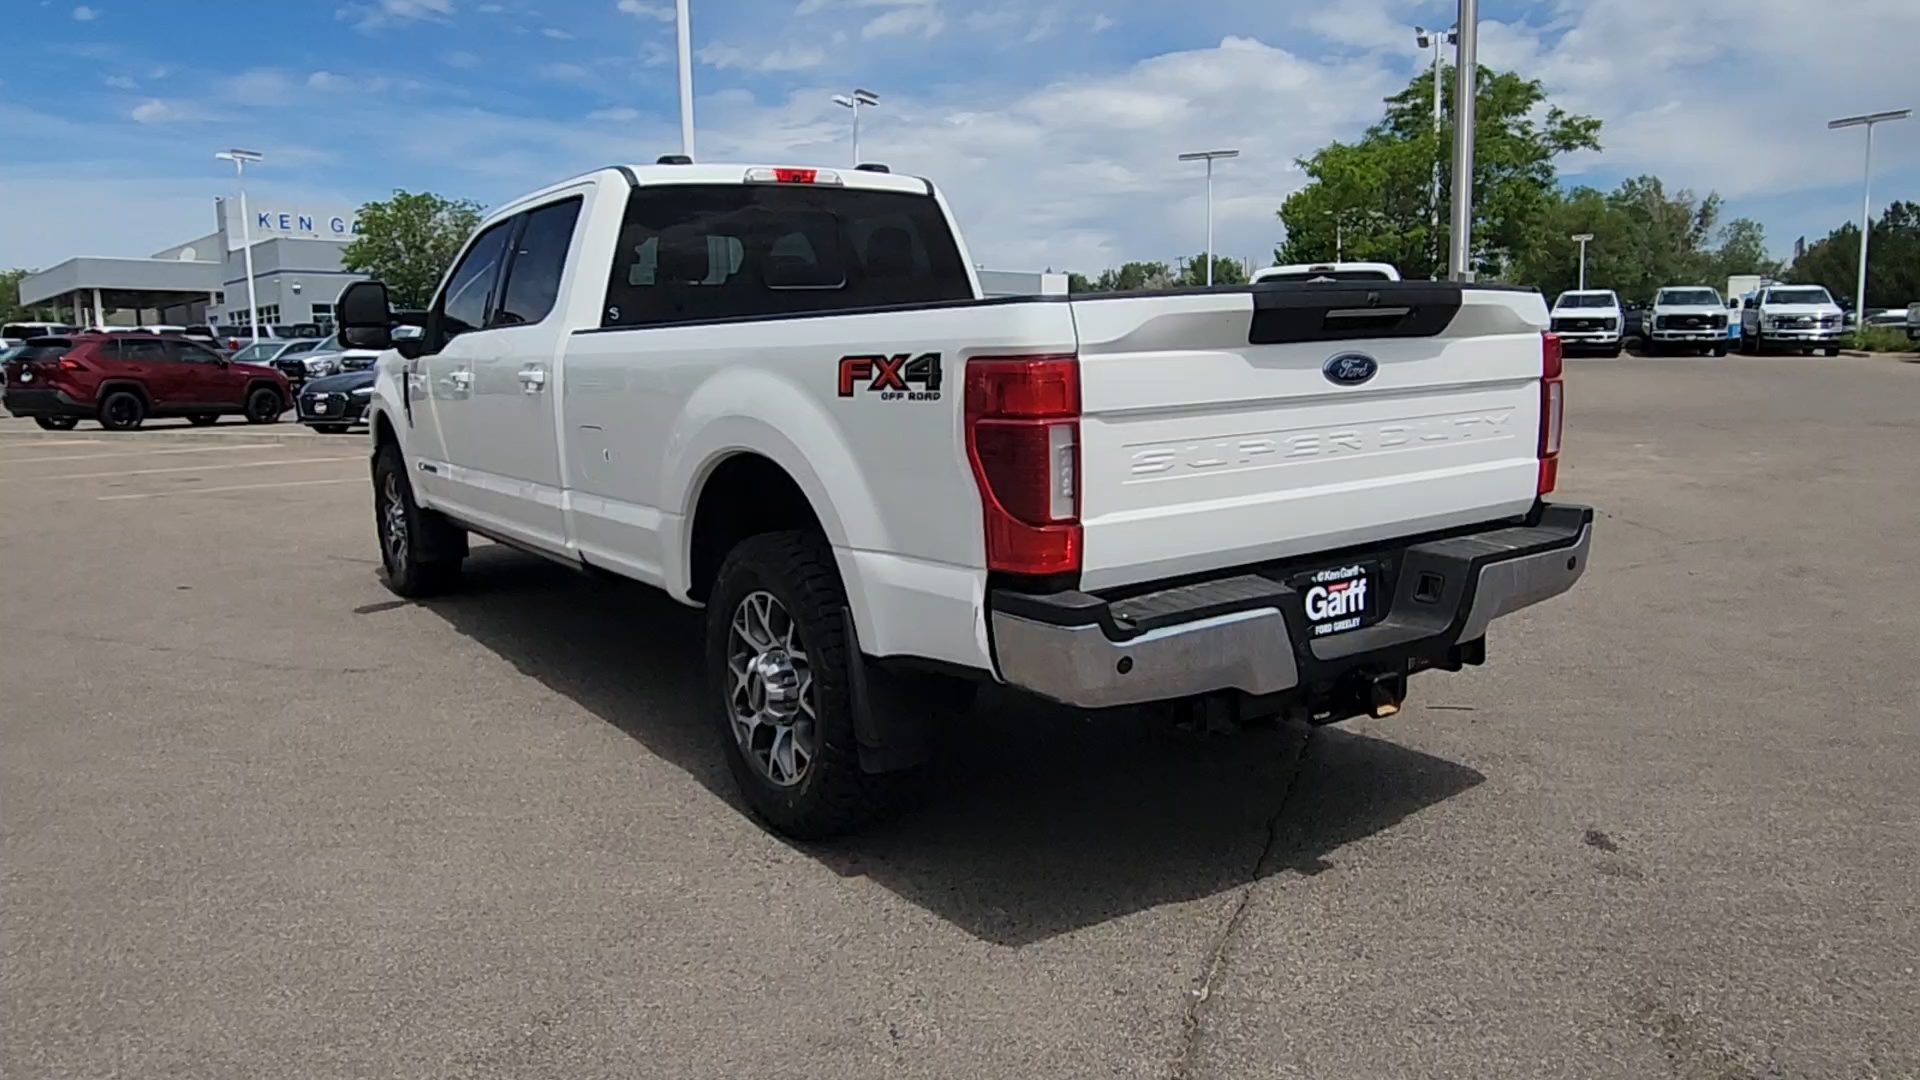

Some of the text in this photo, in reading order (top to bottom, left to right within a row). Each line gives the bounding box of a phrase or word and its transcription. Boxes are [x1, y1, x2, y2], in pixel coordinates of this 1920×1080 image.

[257, 212, 313, 231] KEN
[838, 352, 943, 398] FX4
[1338, 358, 1368, 378] Ford
[881, 391, 942, 401] OFF ROAD
[1131, 430, 1363, 476] SUPER
[1305, 578, 1367, 621] Garff
[1315, 623, 1333, 635] FORD
